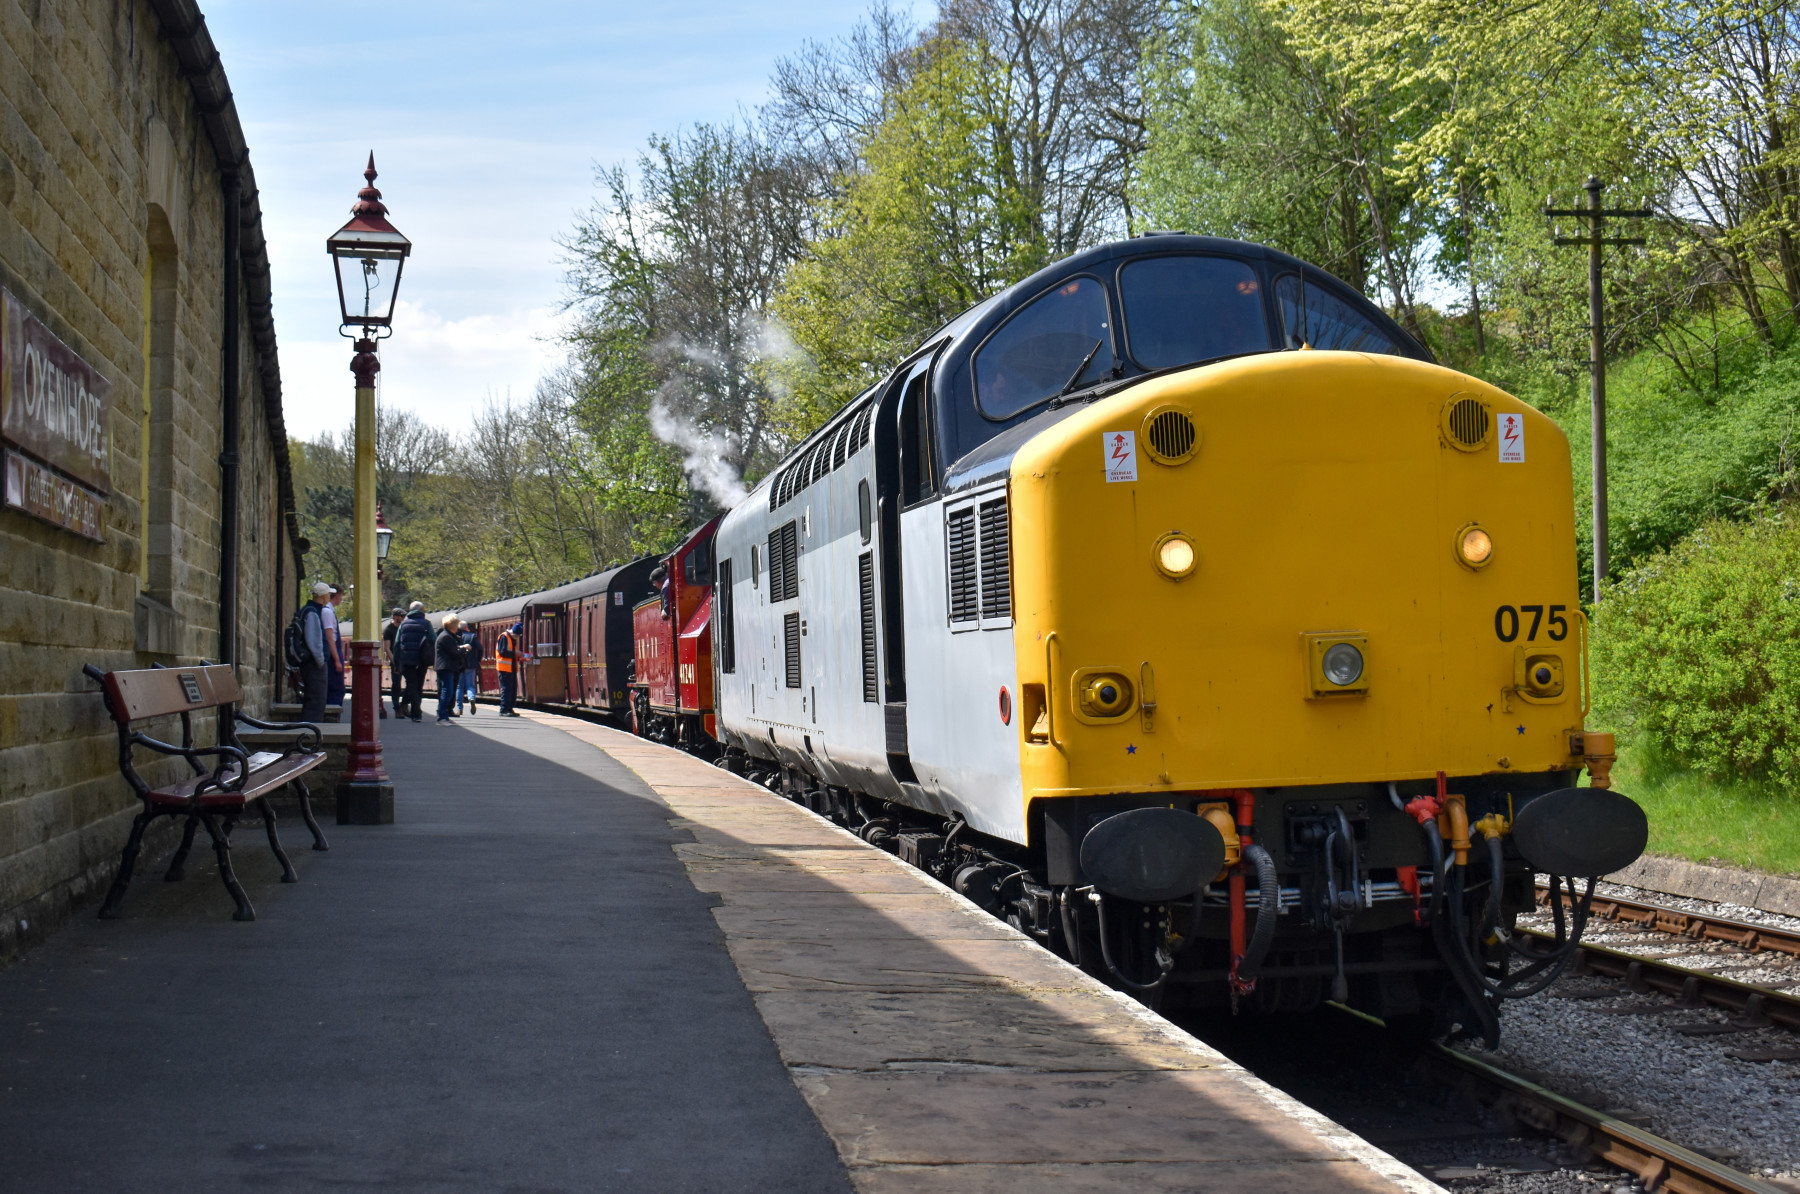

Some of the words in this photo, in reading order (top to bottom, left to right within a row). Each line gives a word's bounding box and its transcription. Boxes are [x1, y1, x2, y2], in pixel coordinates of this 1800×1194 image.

[24, 342, 102, 460] OXENHOPE
[39, 478, 53, 509] FEET
[54, 486, 72, 518] ABOVE
[1495, 605, 1568, 643] 075
[680, 663, 695, 684] 41241
[613, 690, 623, 700] 10
